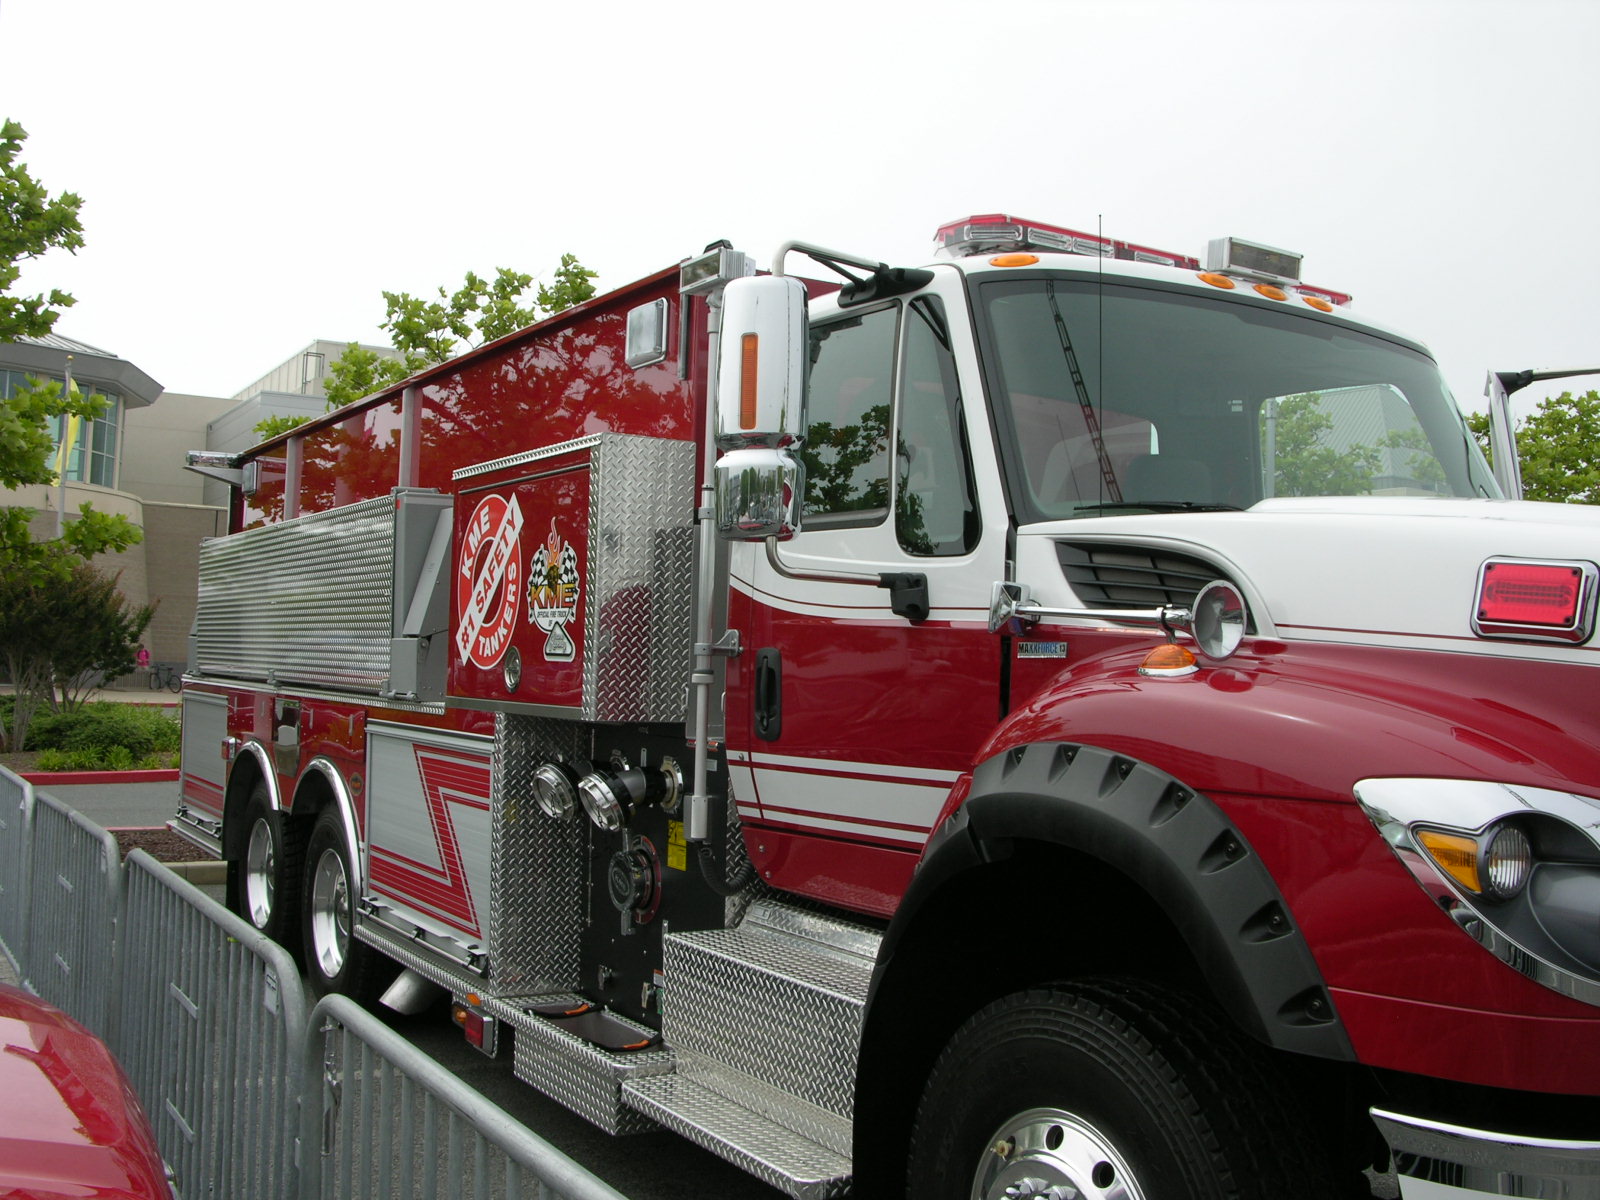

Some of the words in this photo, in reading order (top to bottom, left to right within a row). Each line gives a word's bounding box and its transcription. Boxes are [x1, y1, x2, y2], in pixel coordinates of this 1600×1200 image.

[460, 617, 476, 651] #1
[475, 507, 518, 614] SAFETY
[461, 505, 490, 580] KME
[478, 561, 518, 658] TANKERS
[530, 583, 575, 609] KME
[1018, 643, 1058, 654] MAXXFORCE
[1059, 644, 1066, 653] 13
